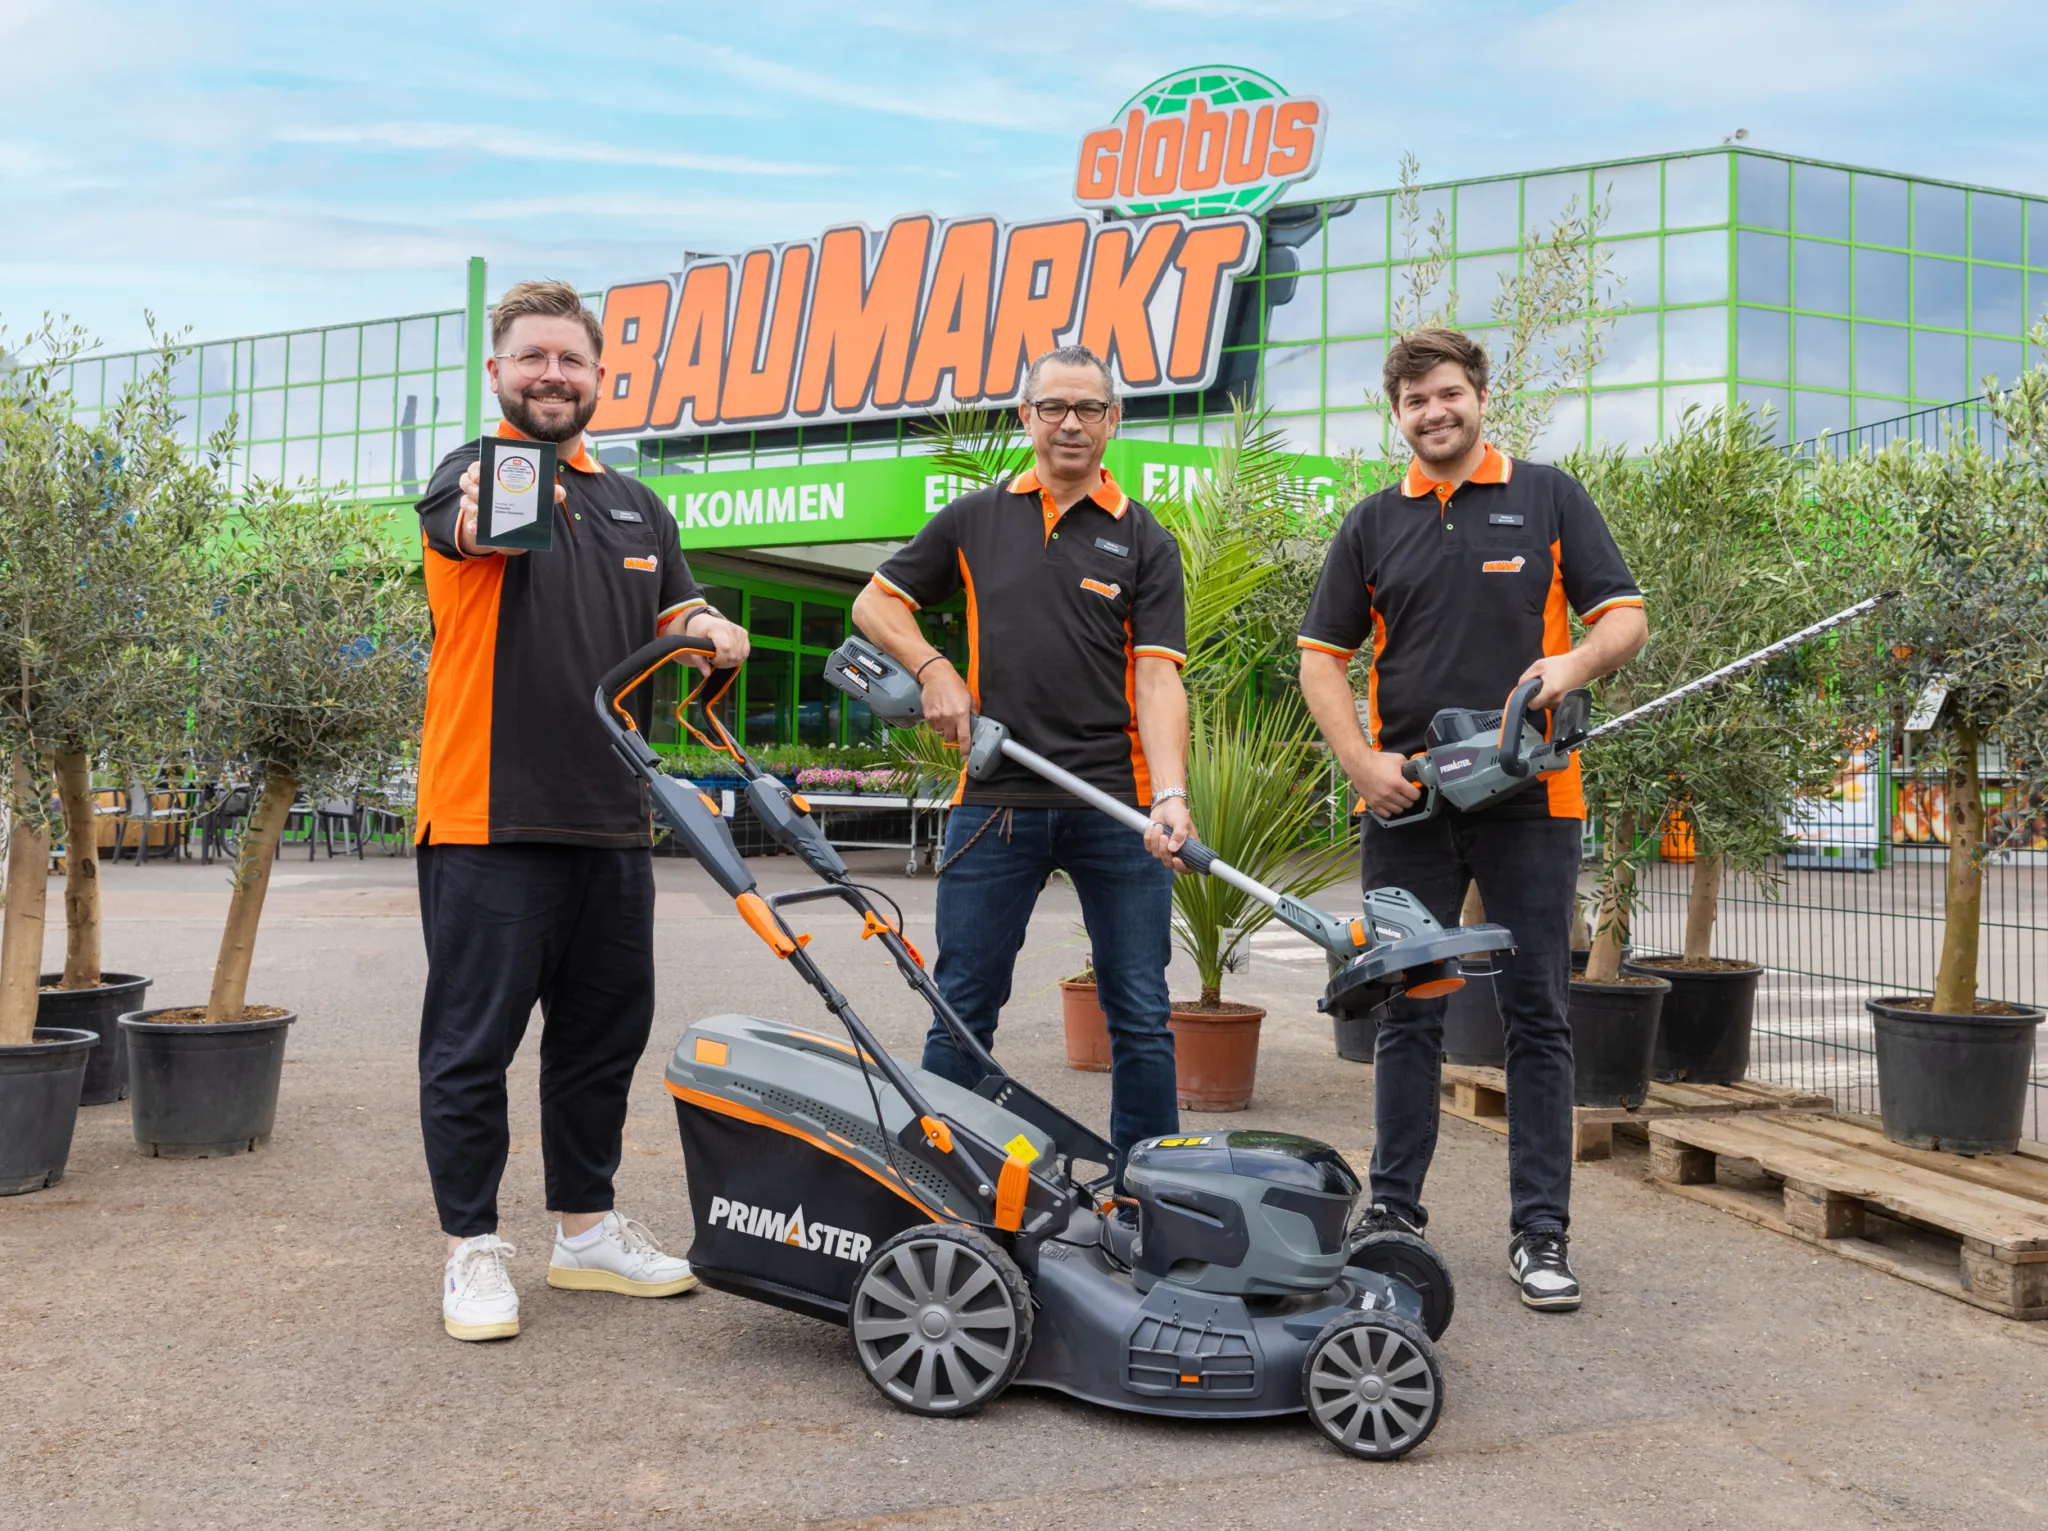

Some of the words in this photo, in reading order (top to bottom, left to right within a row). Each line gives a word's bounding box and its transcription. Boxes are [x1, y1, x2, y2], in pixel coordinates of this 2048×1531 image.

[1077, 98, 1319, 199] Globus
[586, 214, 1249, 434] BAUMARKT
[708, 1195, 872, 1264] PRIMASTER
